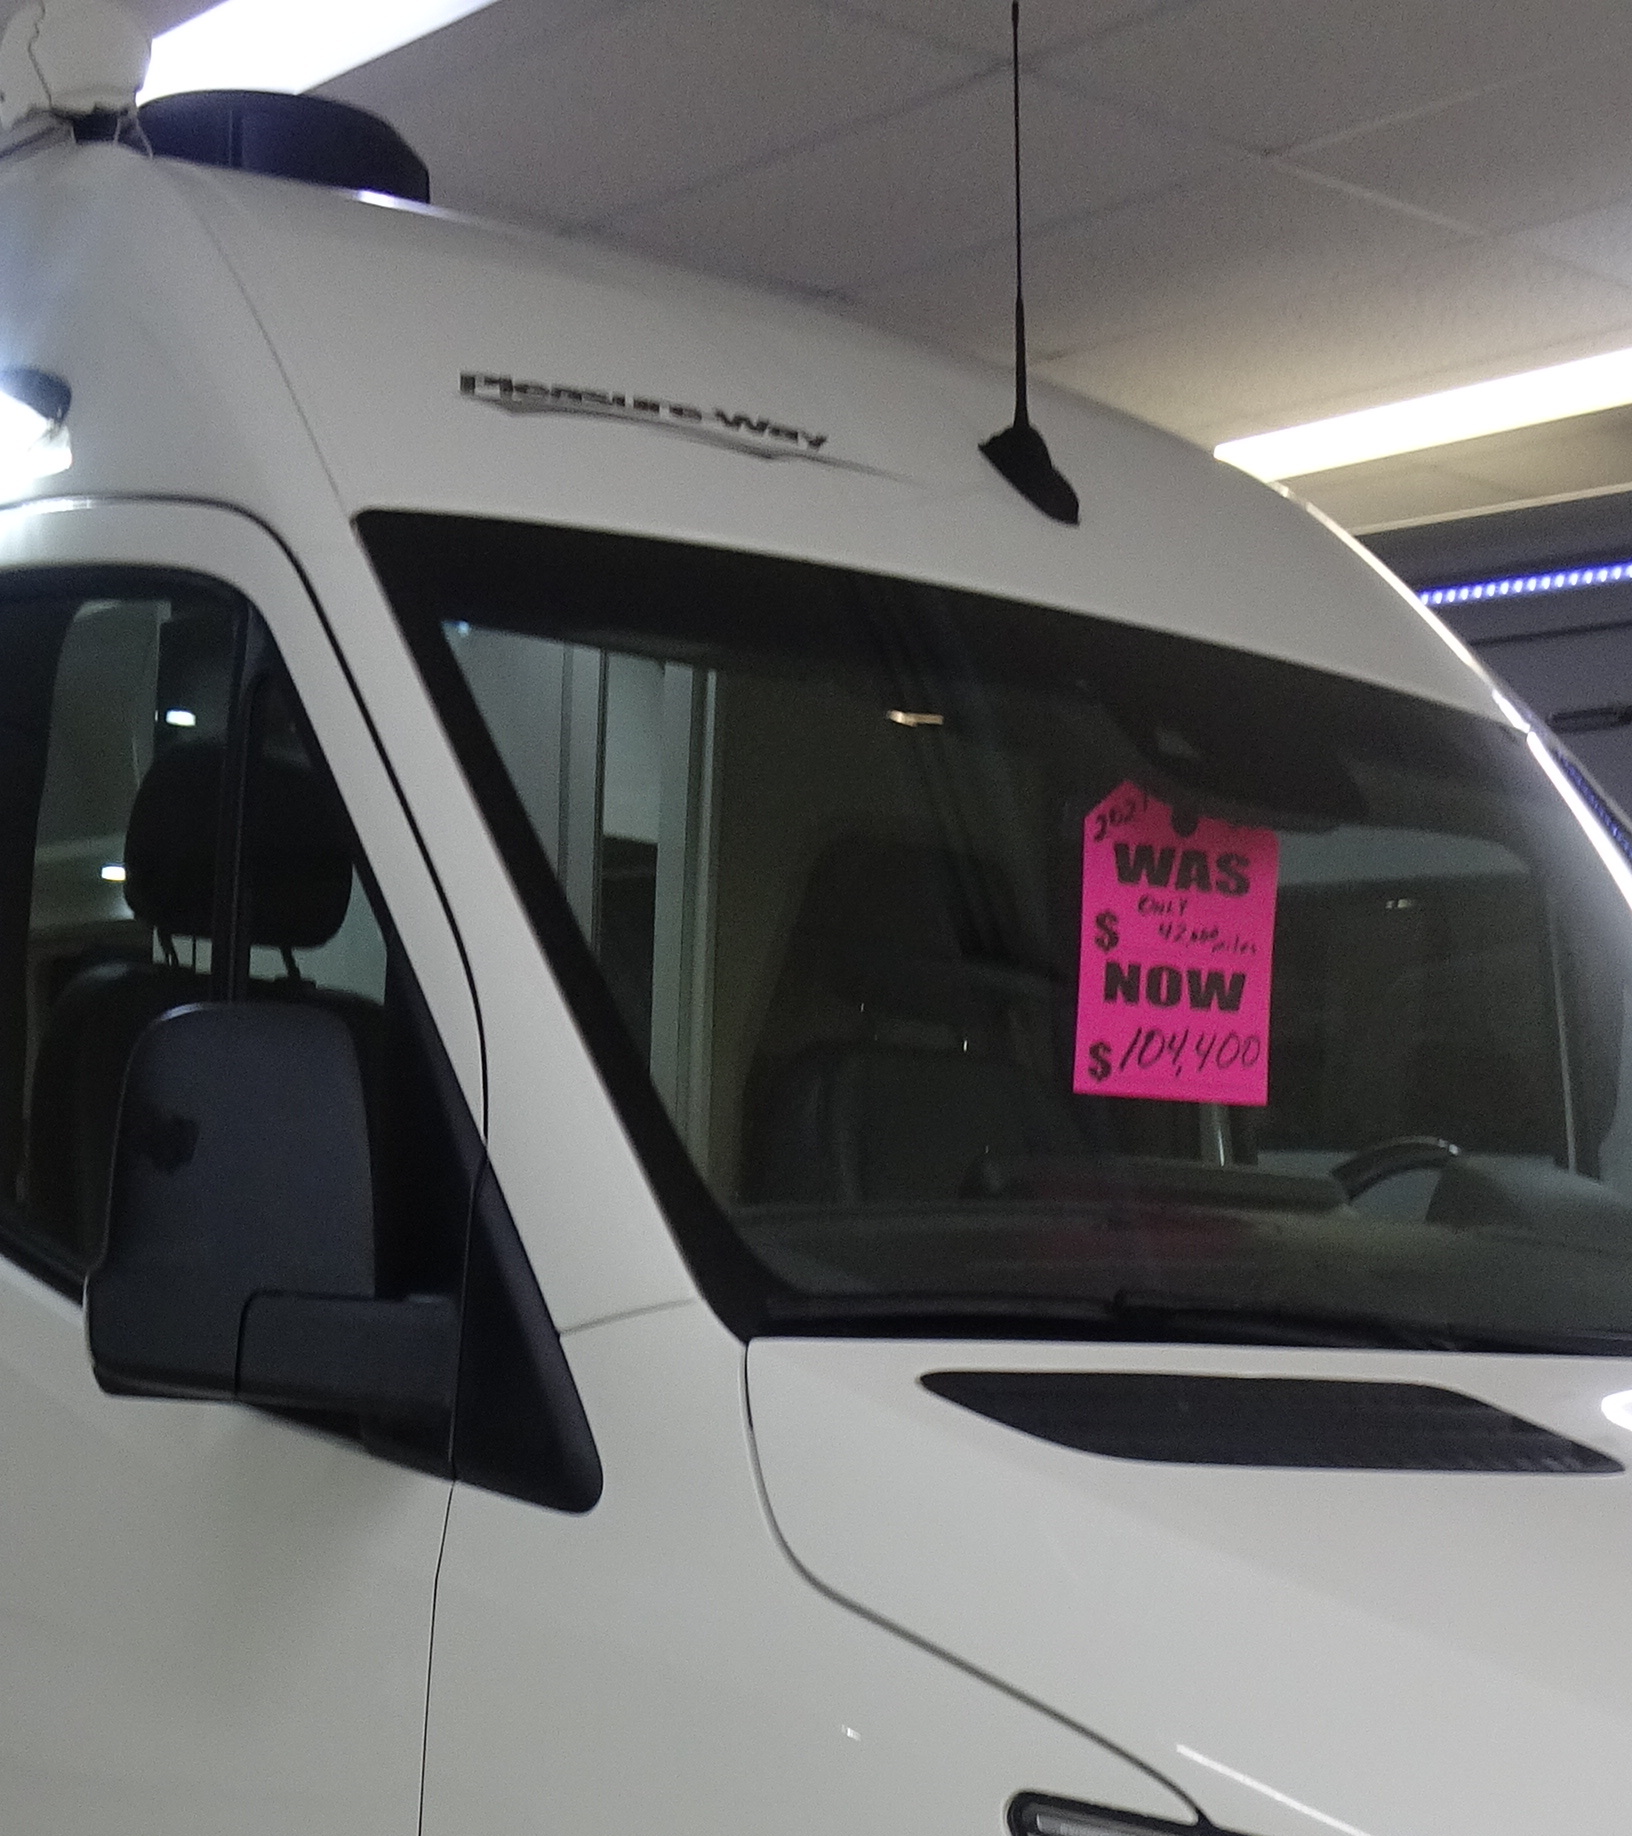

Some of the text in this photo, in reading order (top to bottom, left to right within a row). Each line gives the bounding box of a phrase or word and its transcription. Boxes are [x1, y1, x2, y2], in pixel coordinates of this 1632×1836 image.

[1114, 843, 1250, 897] WAS
[1095, 910, 1119, 951] $
[1104, 961, 1246, 1014] NOW
